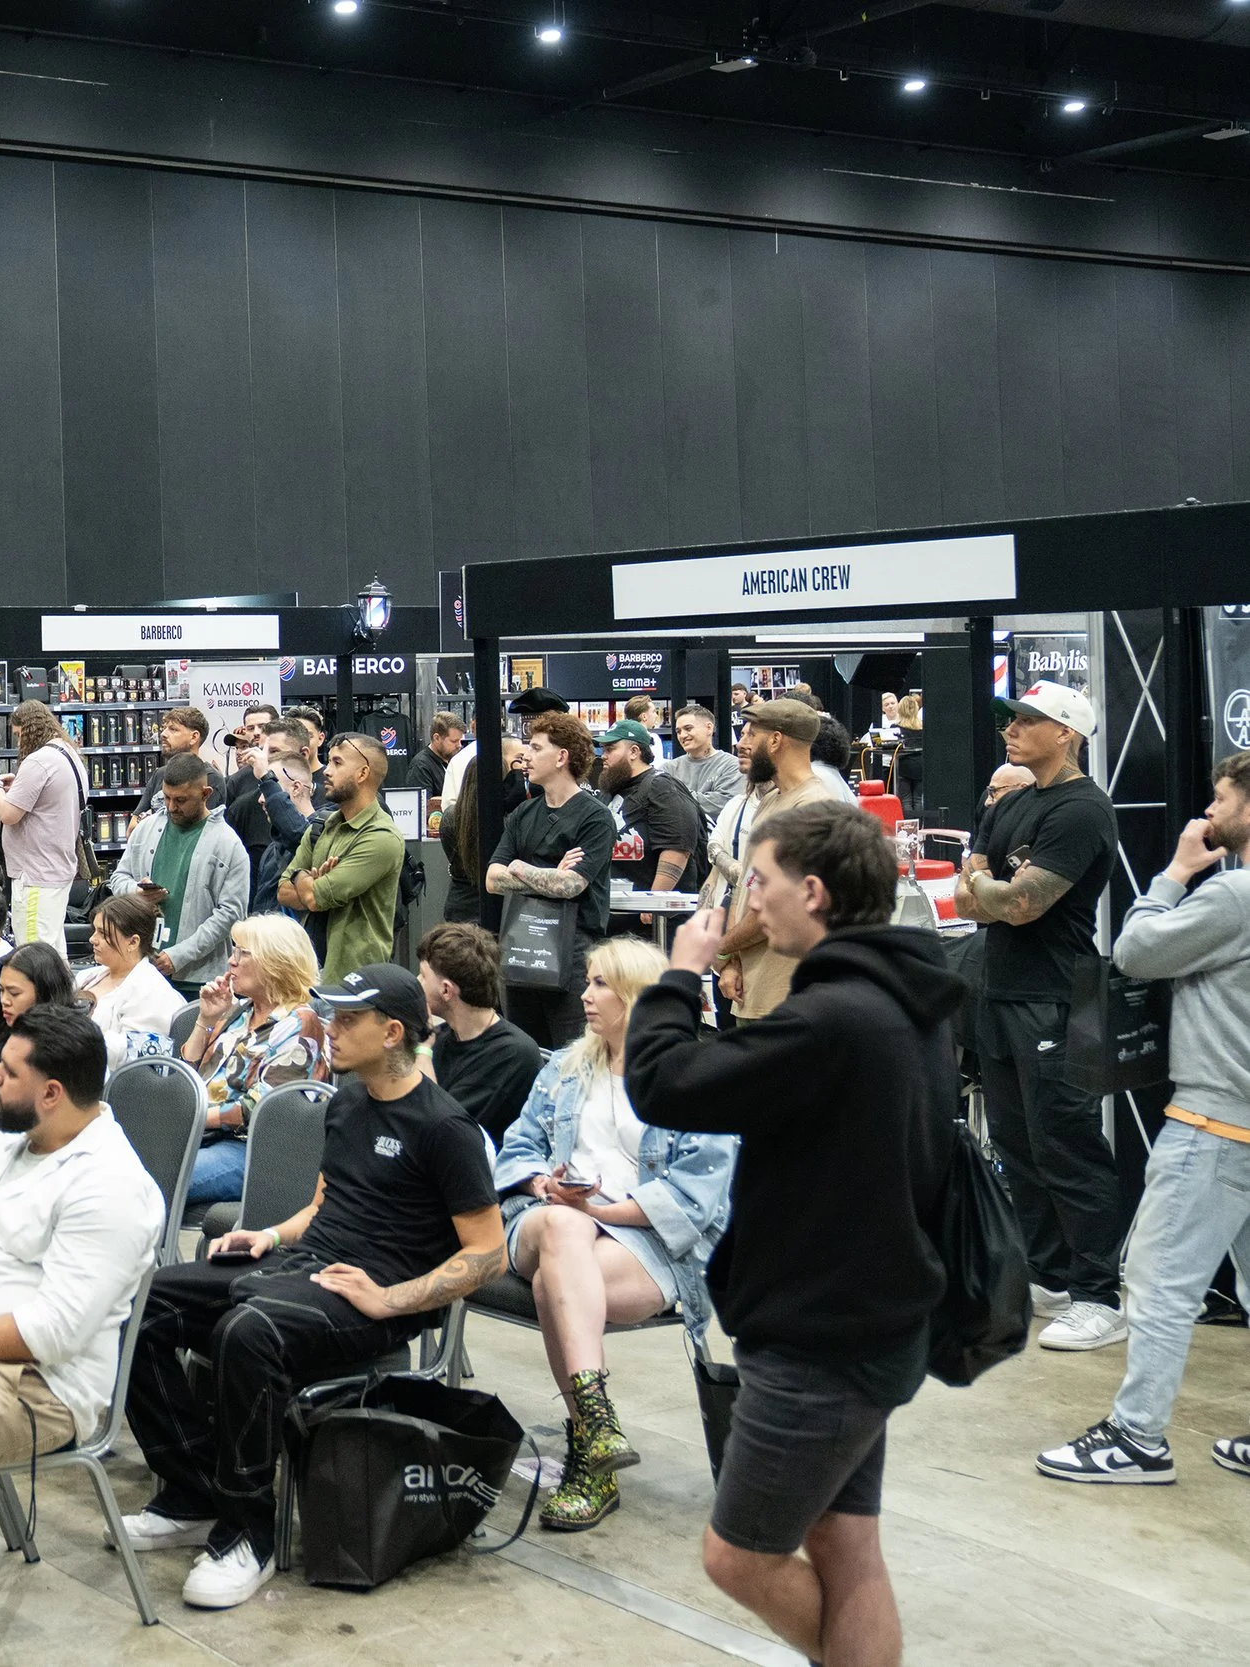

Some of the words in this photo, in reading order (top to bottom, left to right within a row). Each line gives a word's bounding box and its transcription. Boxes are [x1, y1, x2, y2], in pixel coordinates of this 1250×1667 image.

[742, 567, 808, 595] AMERICAN
[812, 564, 851, 591] CREW
[141, 625, 182, 640] BARBERCO
[619, 653, 662, 662] BARBERCO
[1028, 649, 1088, 677] BaBylis
